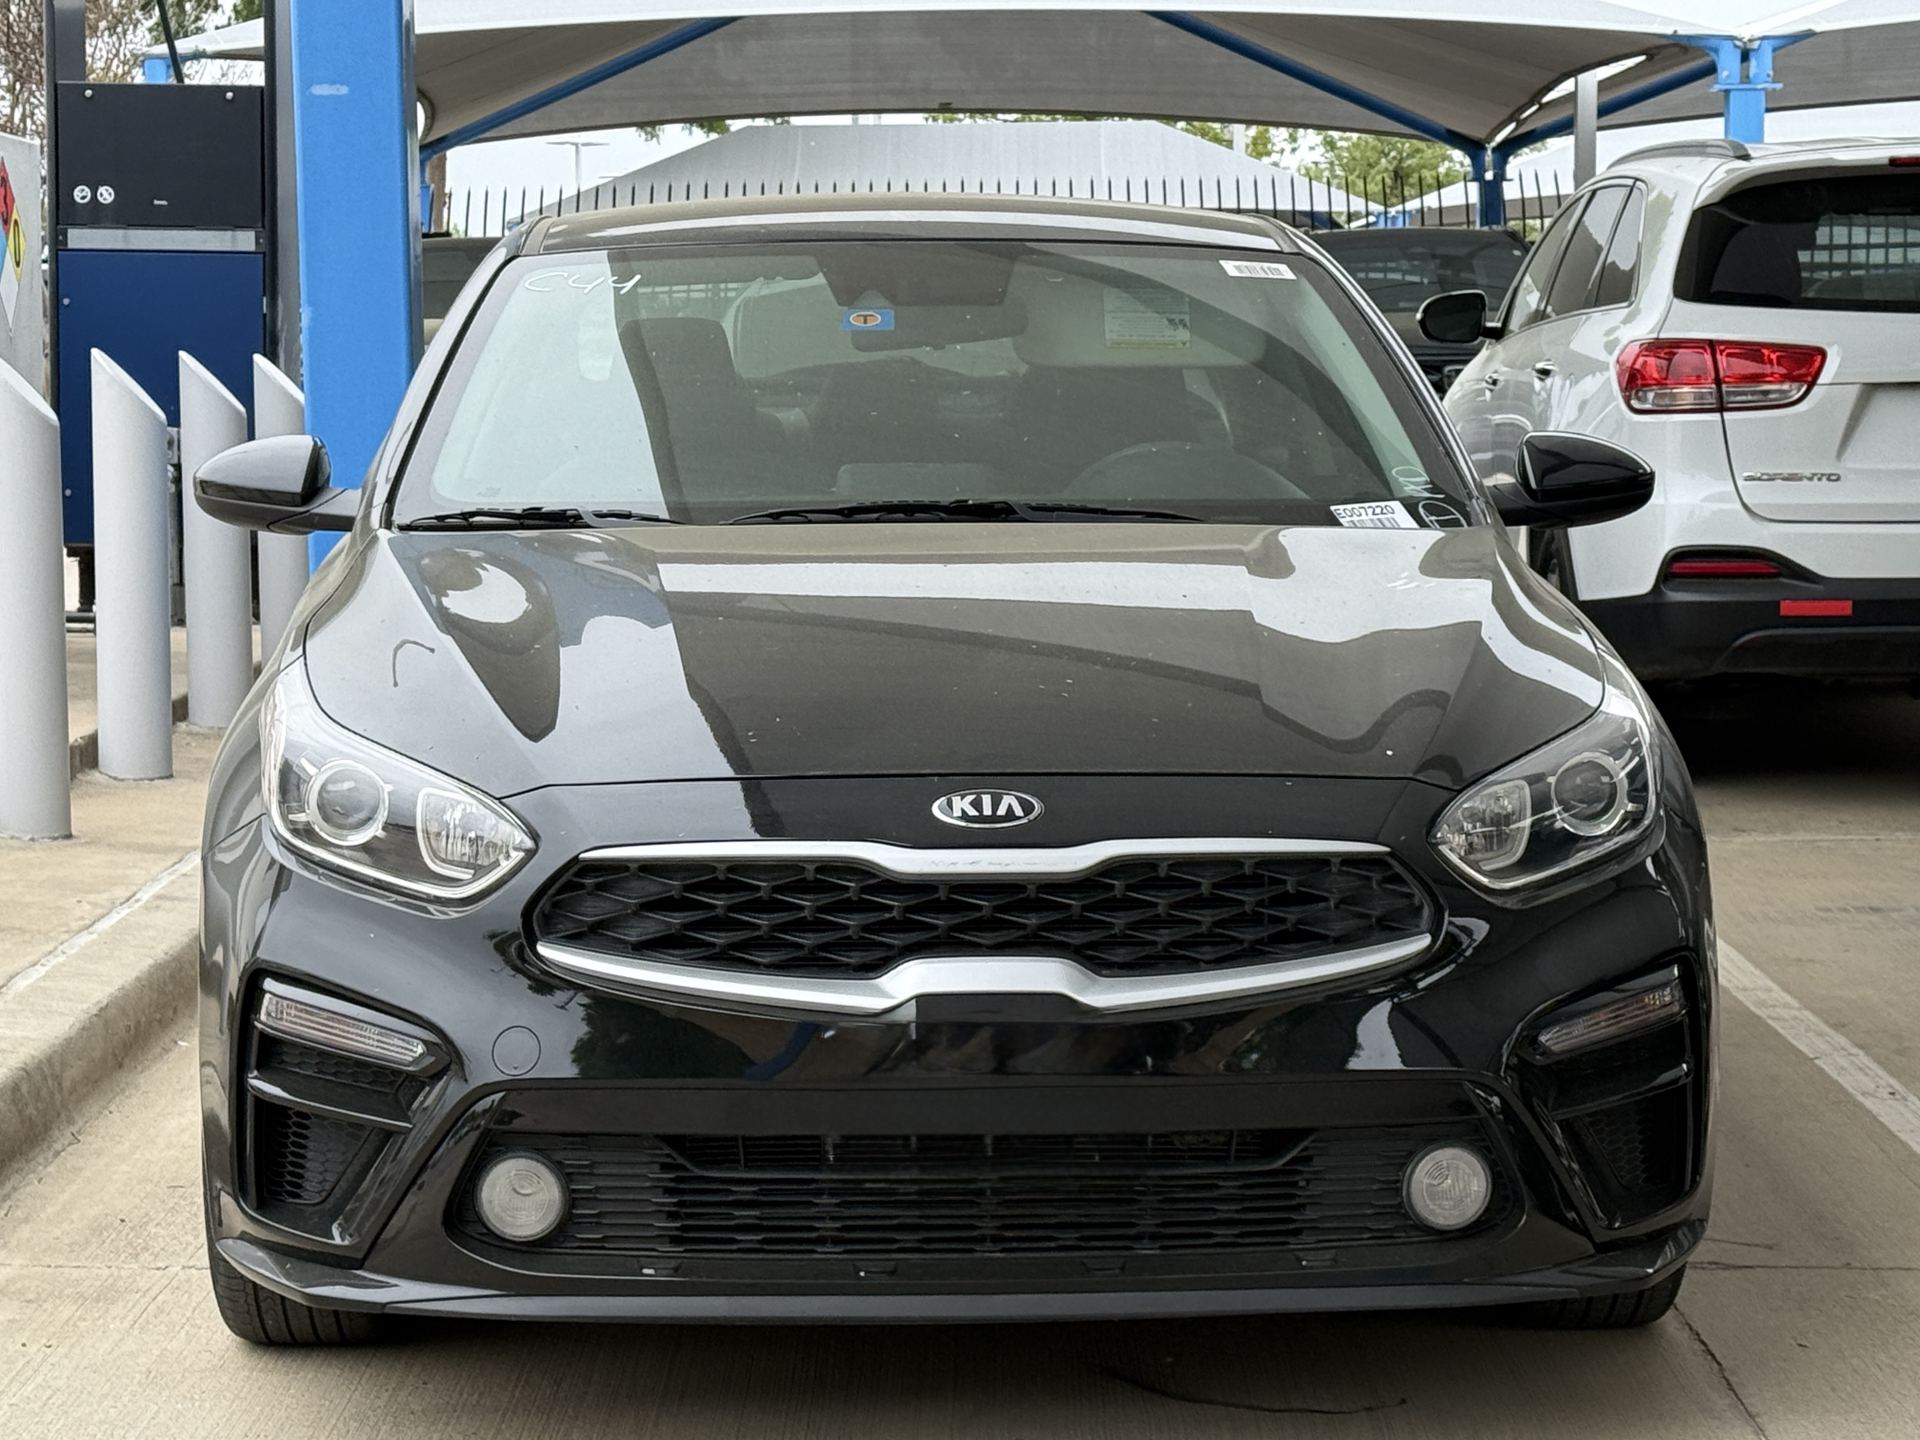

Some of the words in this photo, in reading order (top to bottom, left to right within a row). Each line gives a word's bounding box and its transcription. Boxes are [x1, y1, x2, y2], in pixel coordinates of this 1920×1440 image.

[13, 218, 21, 269] 0
[1333, 504, 1396, 519] E007220
[951, 794, 1025, 817] KIA
